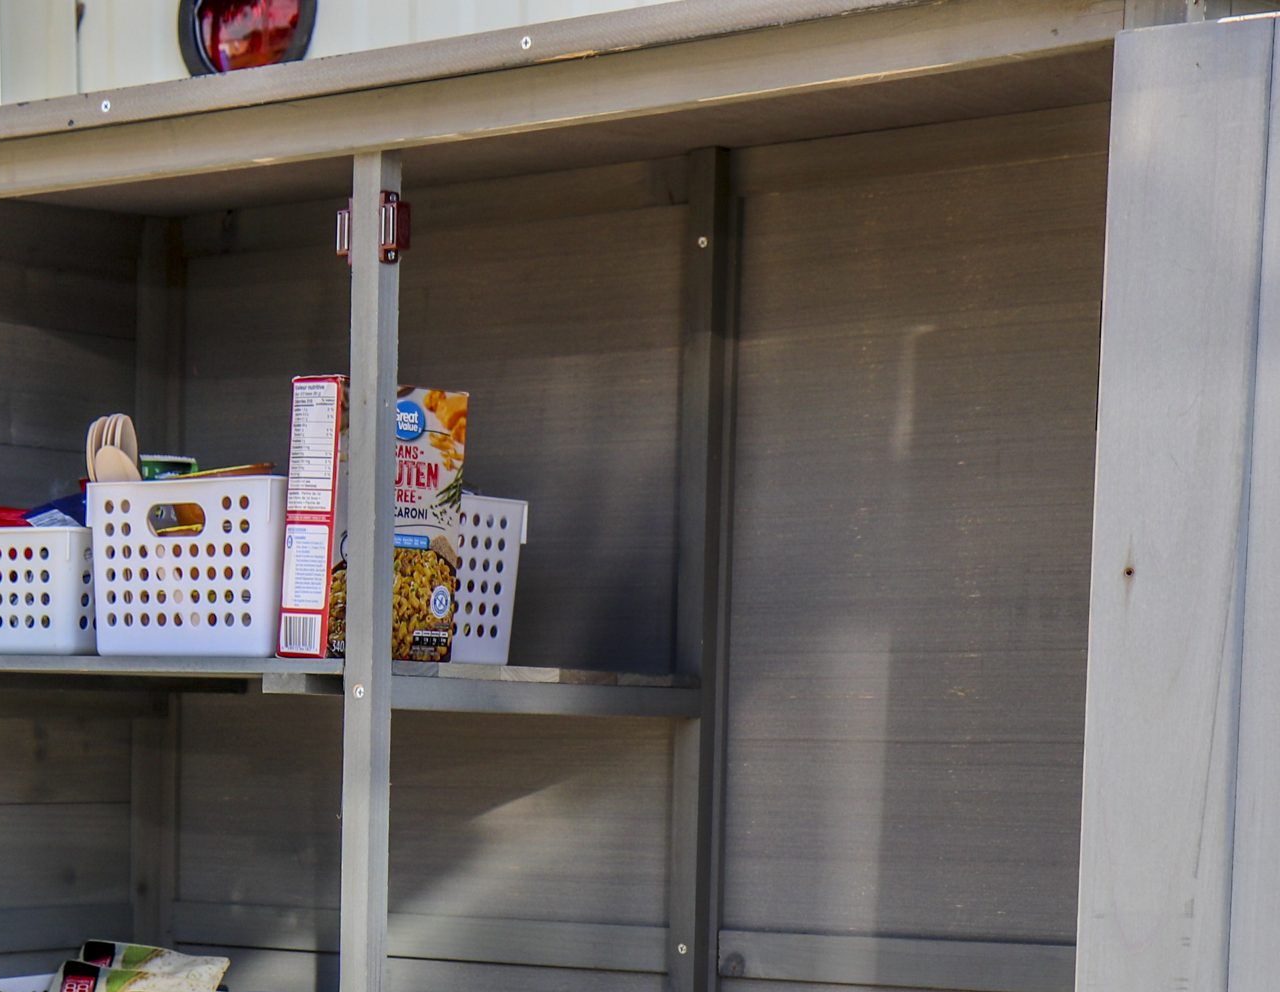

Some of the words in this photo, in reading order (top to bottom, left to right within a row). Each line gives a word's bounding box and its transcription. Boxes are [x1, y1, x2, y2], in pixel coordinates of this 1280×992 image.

[396, 445, 419, 460] ANS
[395, 460, 439, 489] UTEN
[395, 489, 417, 504] REE
[395, 506, 428, 520] ARONI
[331, 640, 345, 653] 340
